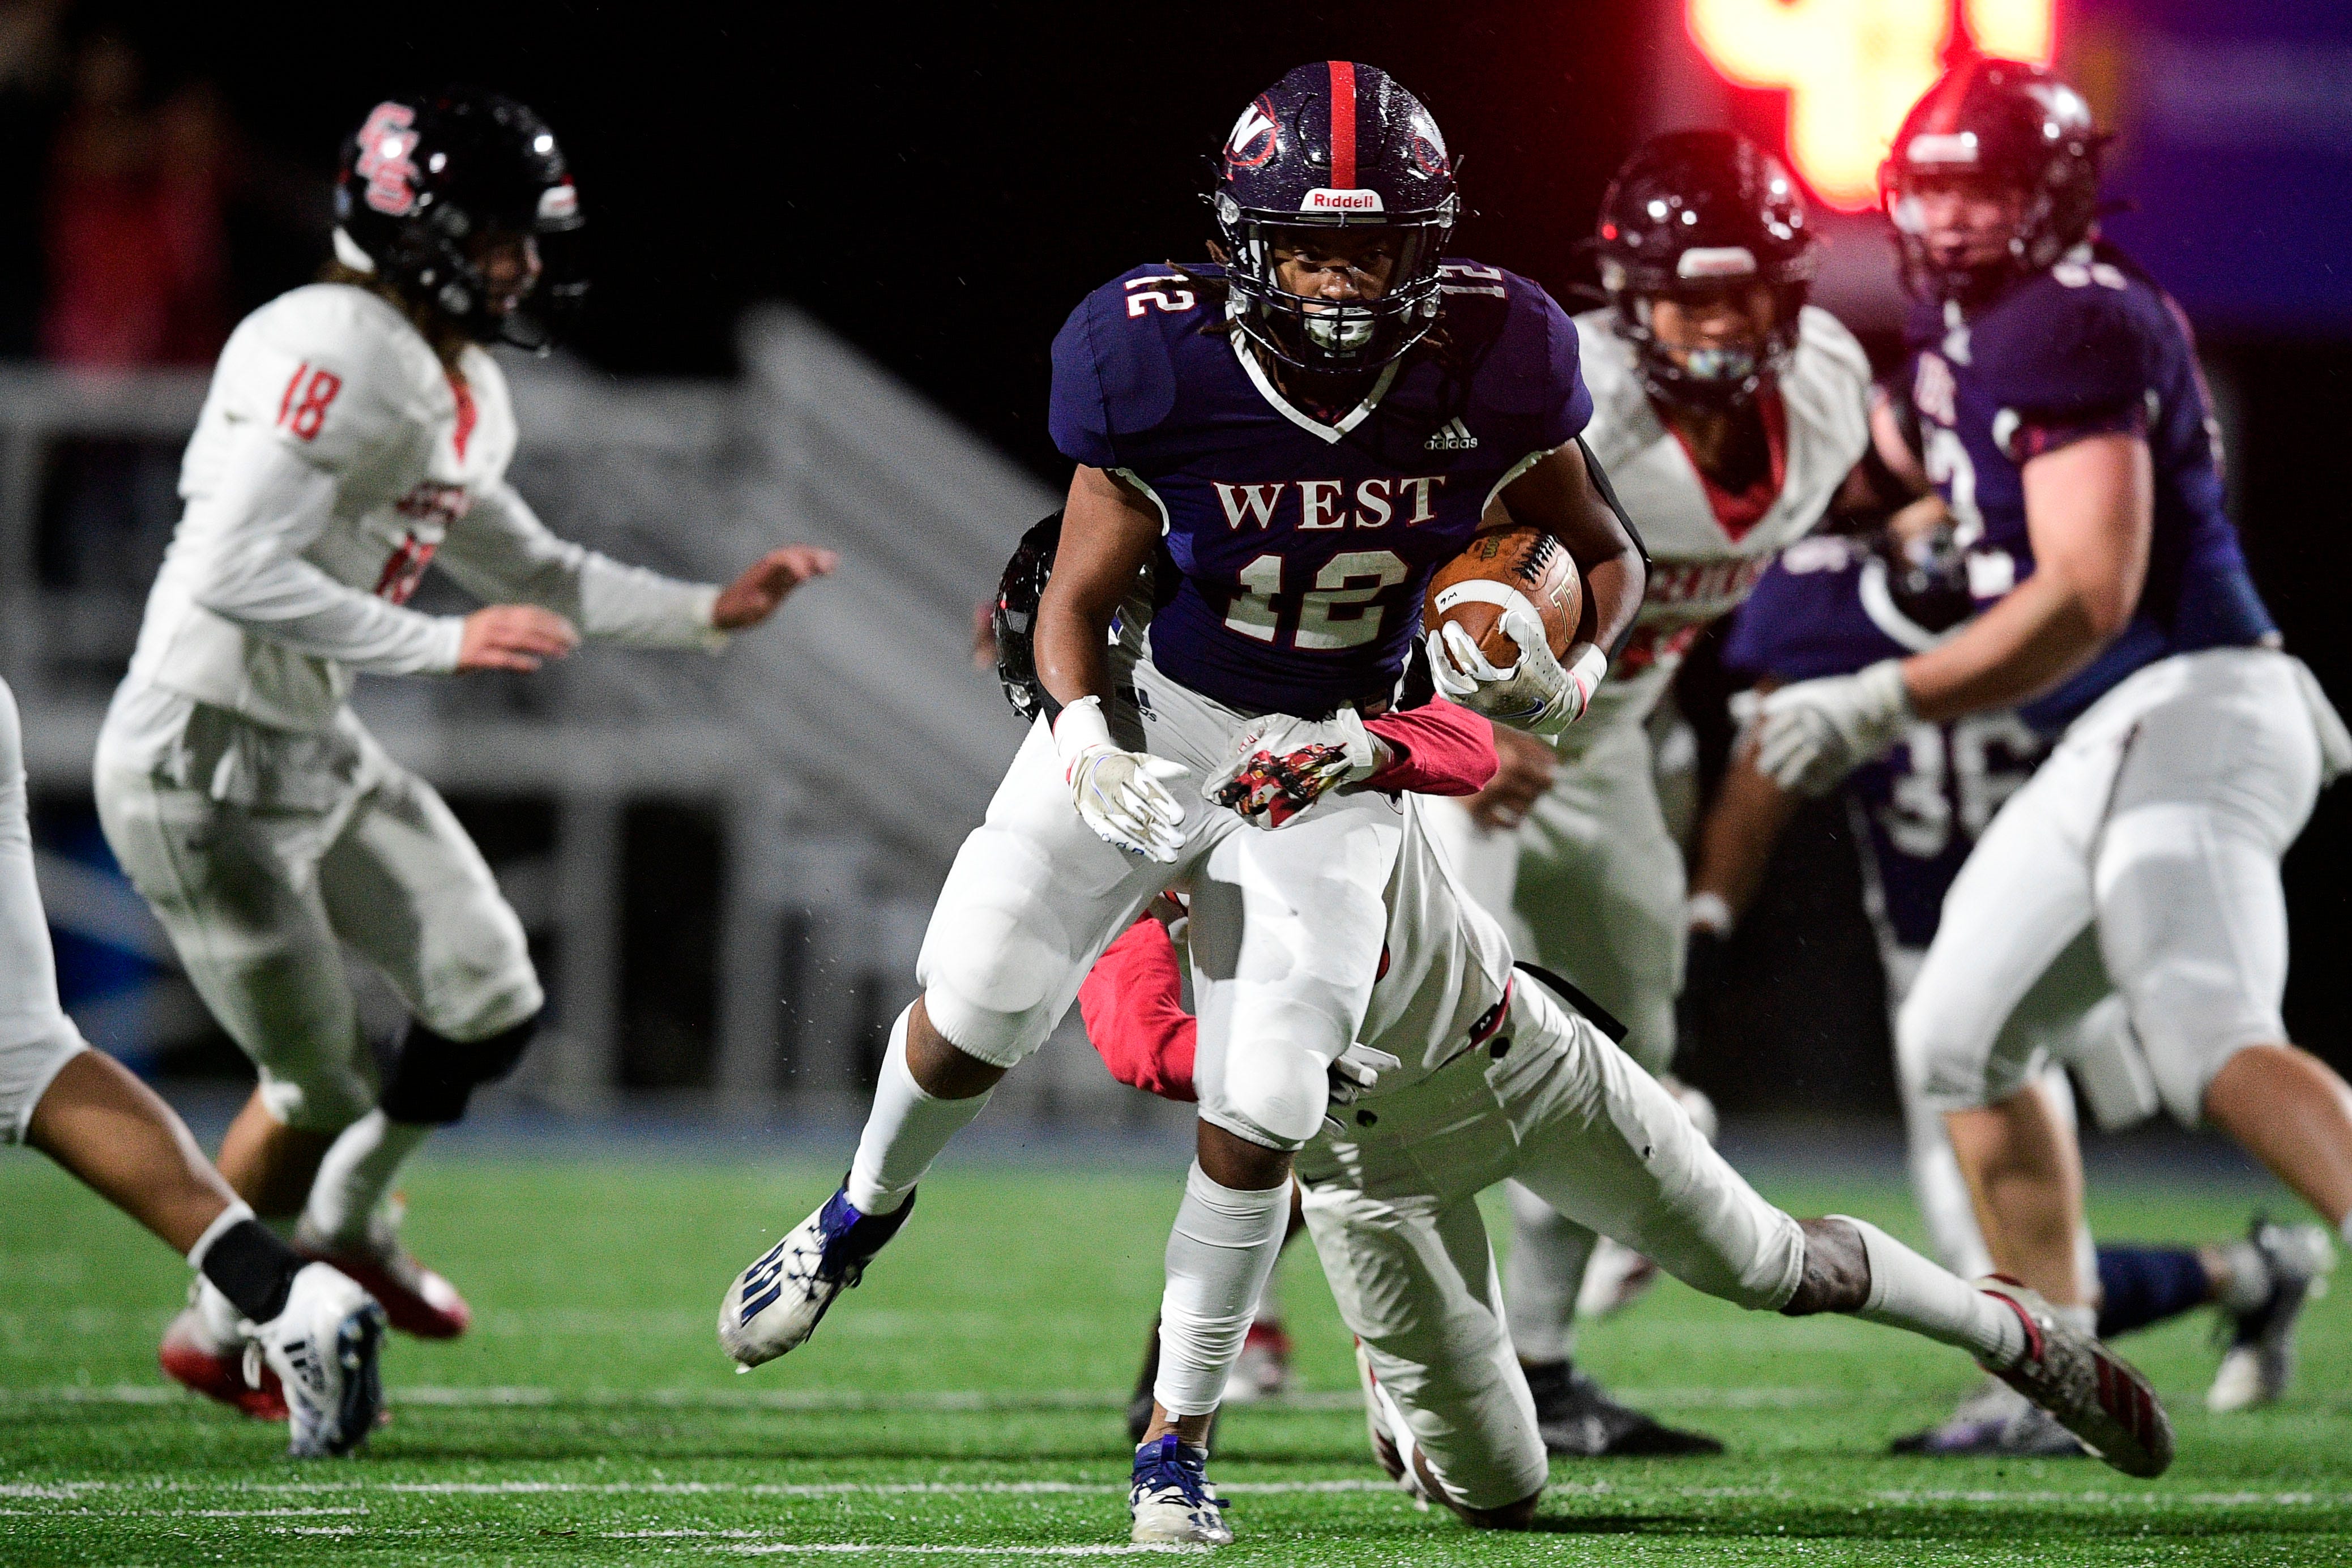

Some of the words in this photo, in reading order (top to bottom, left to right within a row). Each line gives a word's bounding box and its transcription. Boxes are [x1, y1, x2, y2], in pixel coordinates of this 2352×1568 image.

[1313, 193, 1374, 208] Riddell
[1124, 274, 1197, 319] 12
[1440, 264, 1508, 300] 12
[276, 359, 342, 442] 18
[1424, 437, 1478, 450] adidas
[1211, 475, 1448, 531] WEST
[1223, 549, 1410, 651] 12
